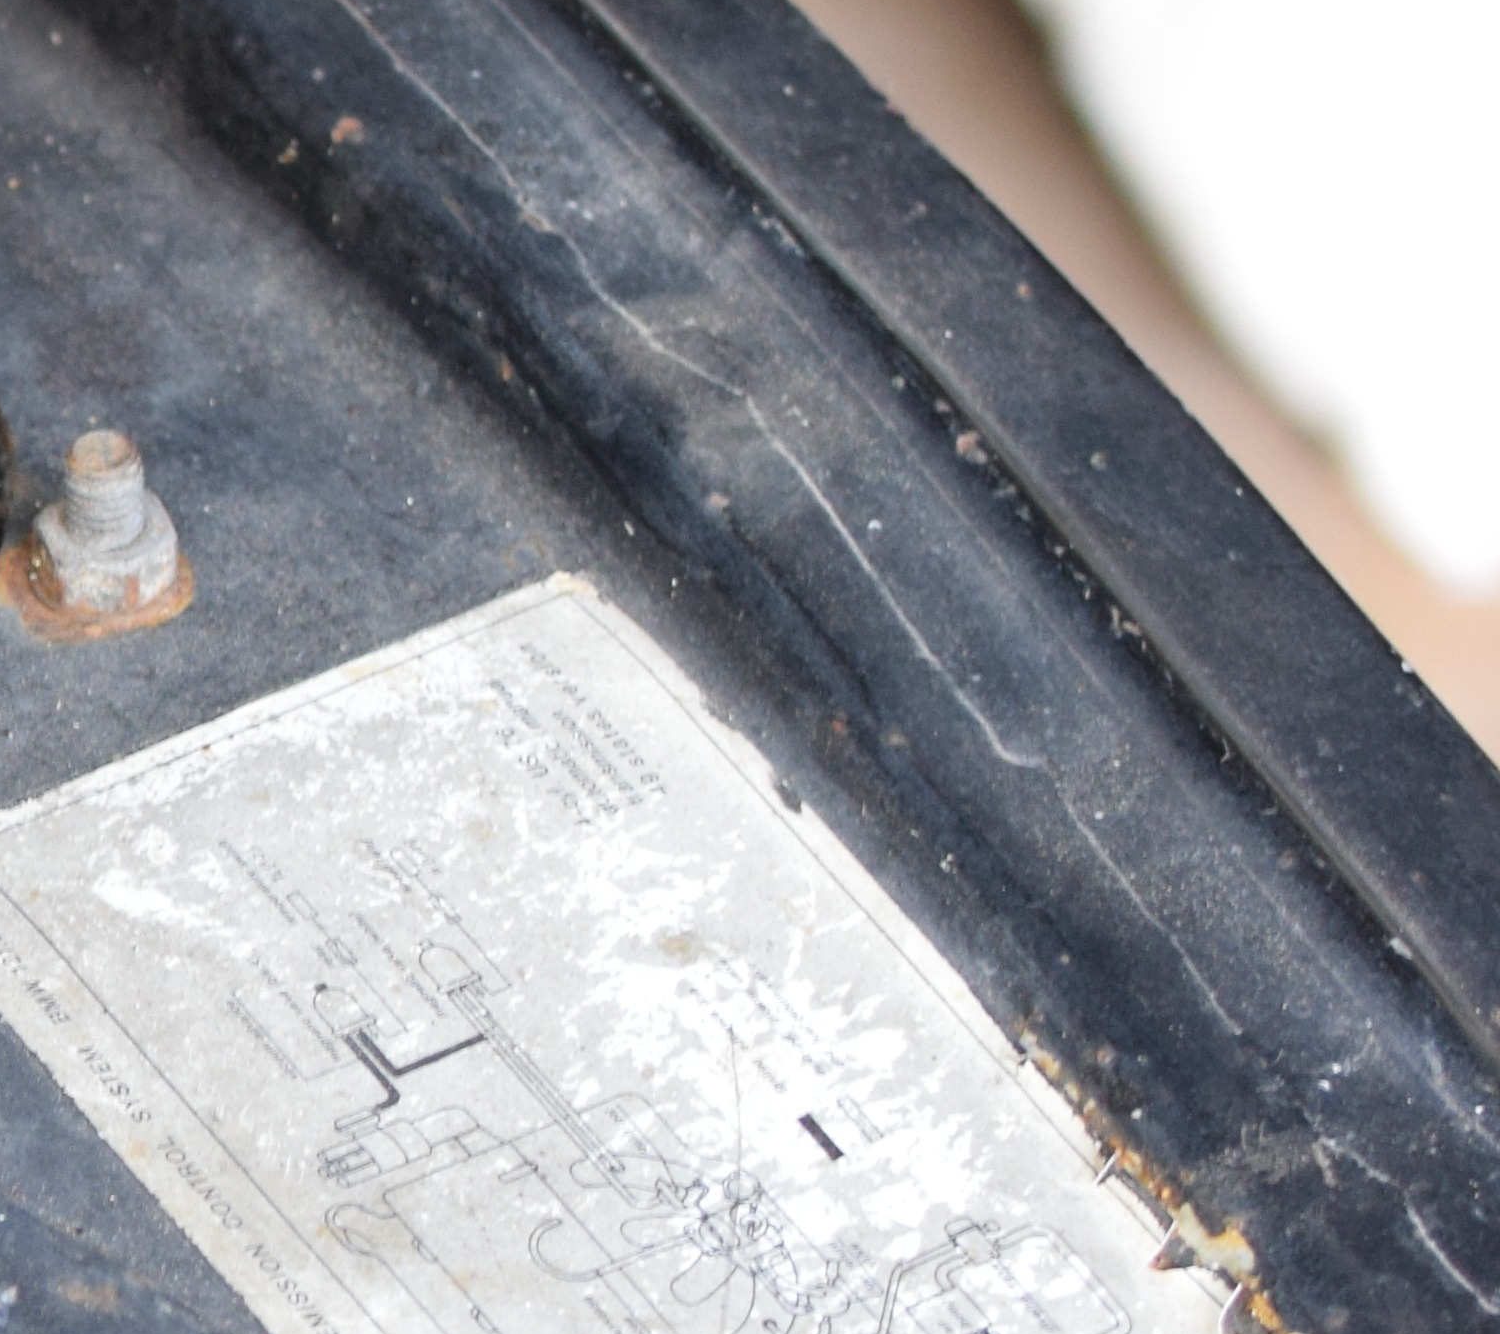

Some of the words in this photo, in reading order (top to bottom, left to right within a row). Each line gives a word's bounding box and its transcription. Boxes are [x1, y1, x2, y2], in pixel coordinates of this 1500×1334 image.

[583, 710, 646, 767] states
[18, 979, 73, 1024] BMW
[72, 1045, 156, 1123] SYSTEM
[151, 1137, 247, 1229] CONTROL
